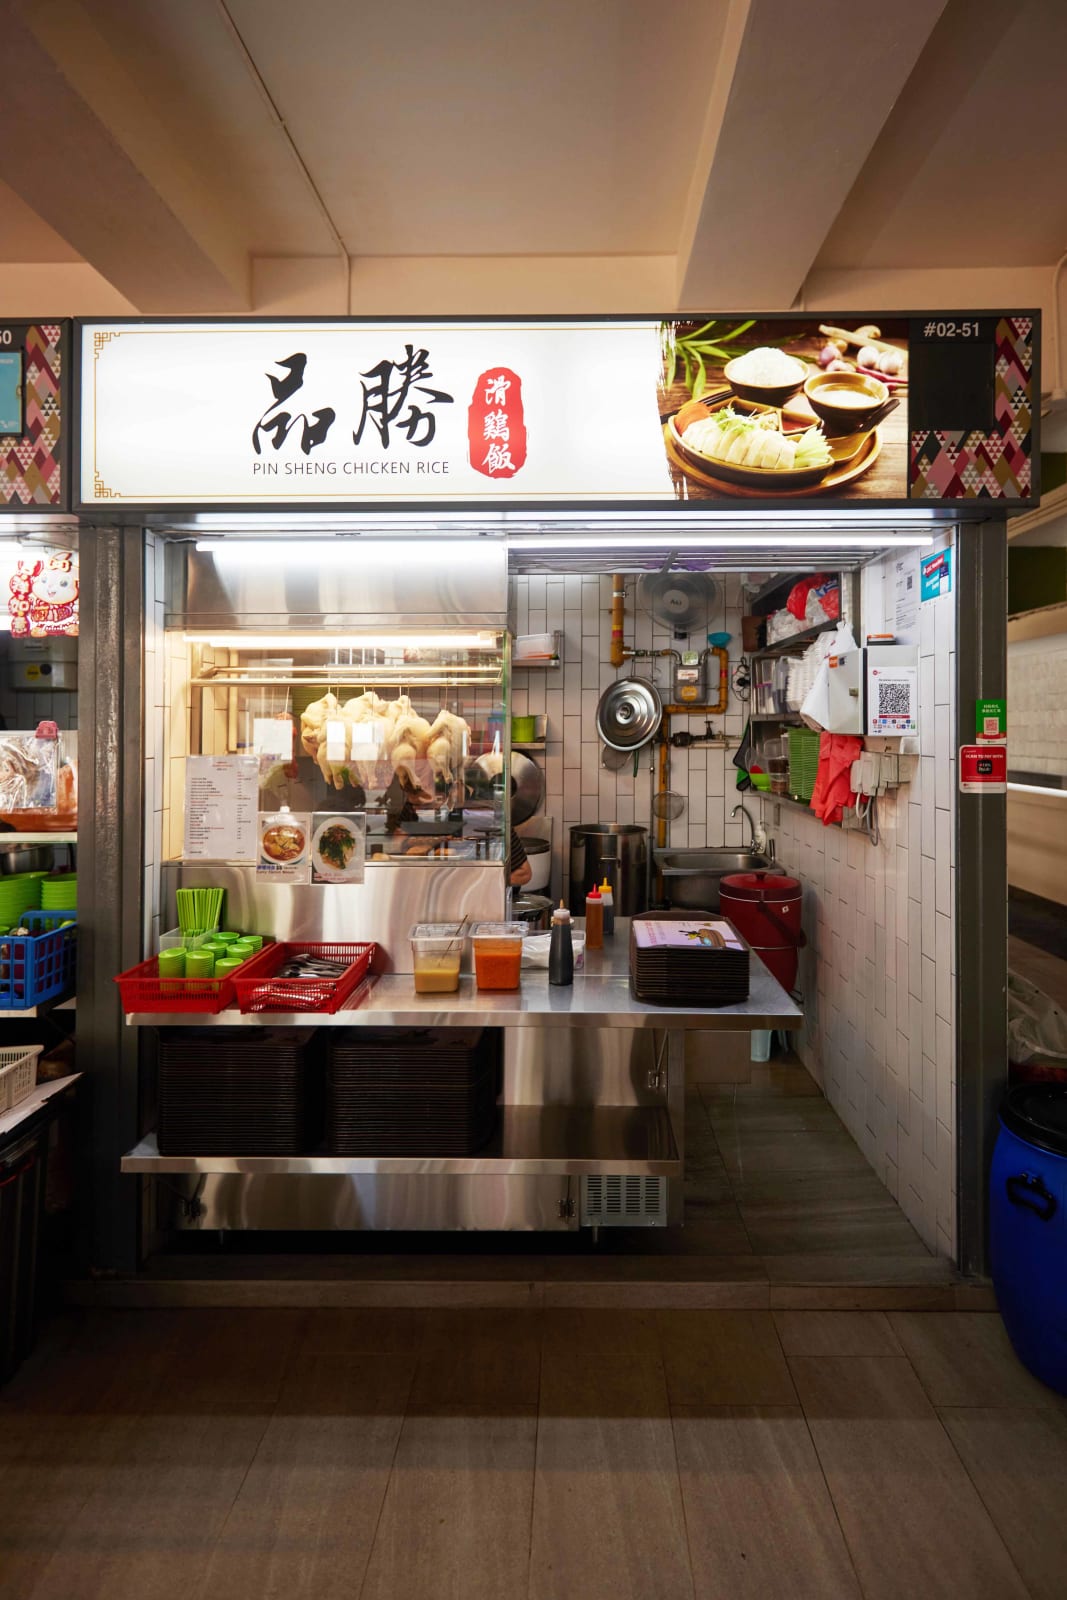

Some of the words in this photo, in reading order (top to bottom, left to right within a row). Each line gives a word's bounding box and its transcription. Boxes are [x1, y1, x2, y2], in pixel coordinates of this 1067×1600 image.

[0, 329, 12, 345] 0
[923, 322, 979, 337] #02-51
[252, 344, 454, 455] 品勝
[253, 463, 278, 475] PIN
[284, 462, 337, 475] SHENG
[343, 462, 410, 474] CHICKEN
[416, 461, 450, 474] RICE
